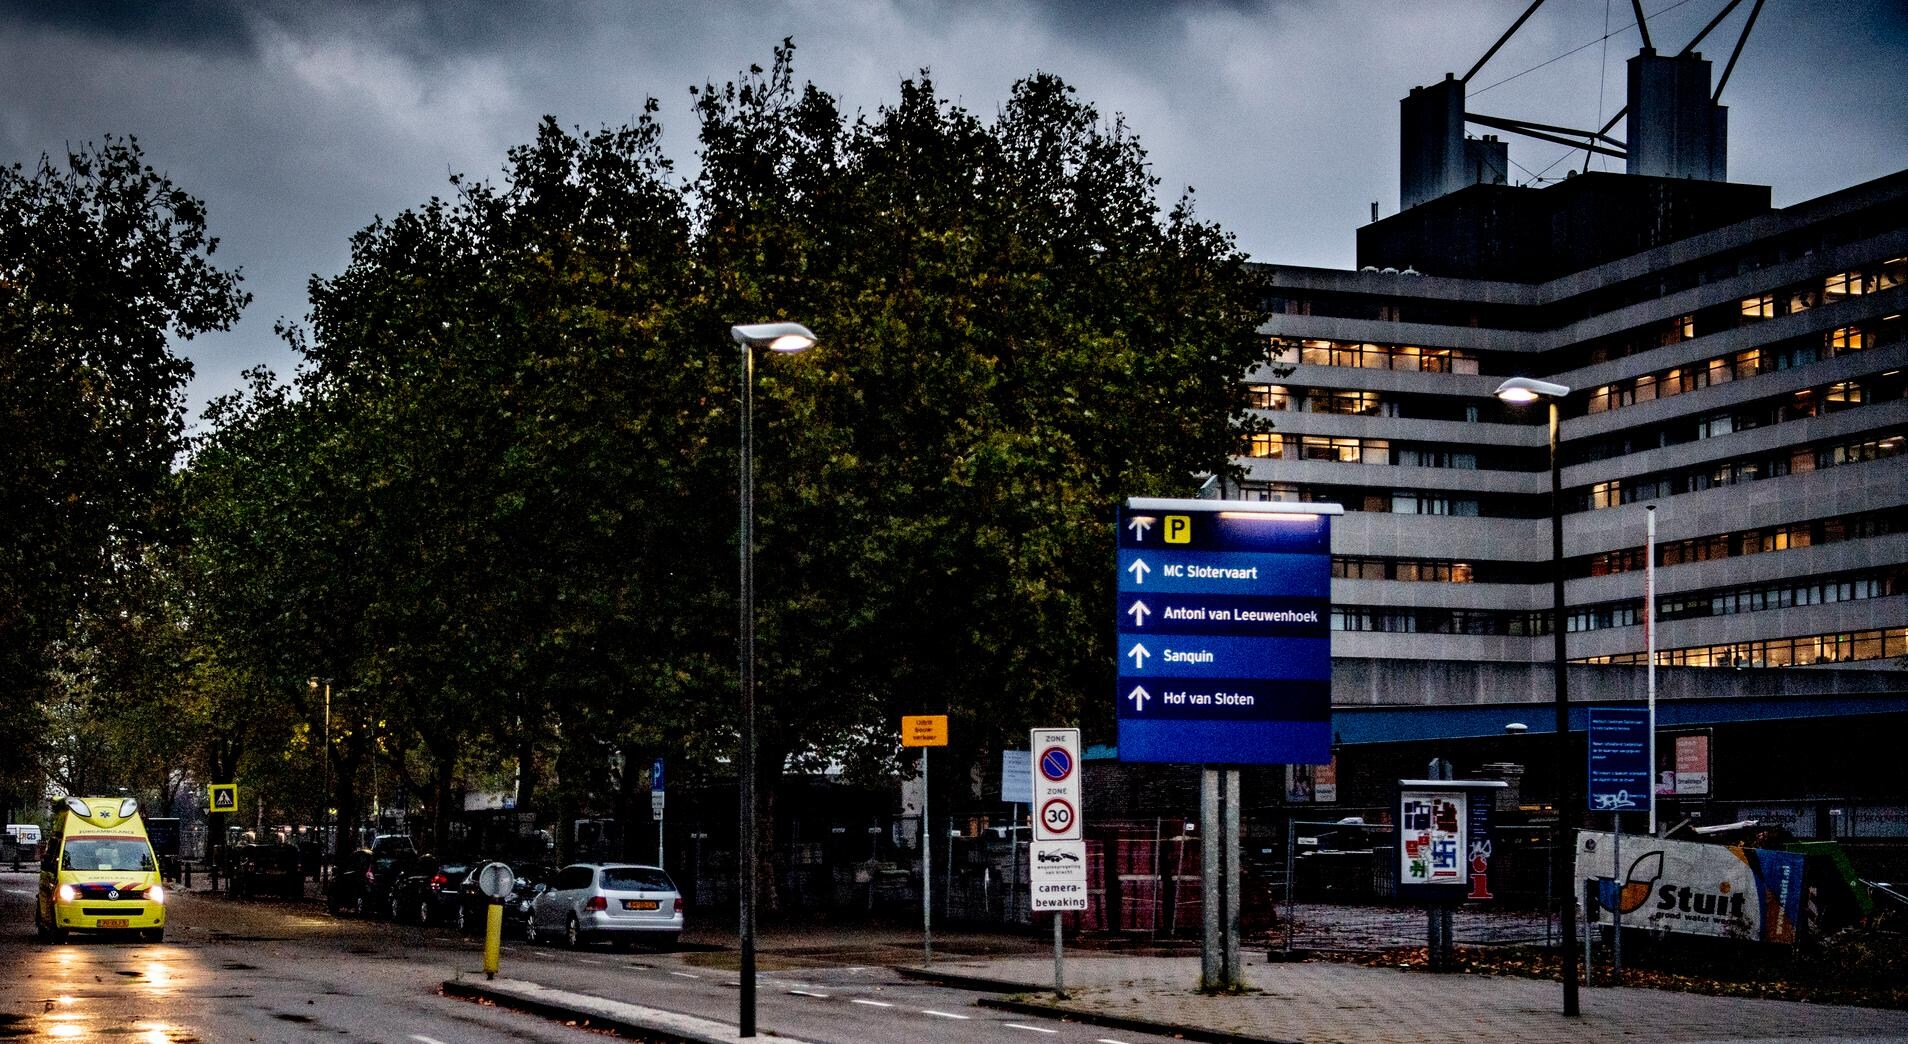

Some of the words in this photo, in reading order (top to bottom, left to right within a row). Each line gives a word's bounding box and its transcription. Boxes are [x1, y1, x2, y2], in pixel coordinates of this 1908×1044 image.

[1171, 519, 1185, 540] P
[1164, 565, 1184, 578] MC
[1187, 565, 1258, 580] Slotervaart
[1163, 606, 1206, 621] Antoni
[1208, 610, 1231, 621] van
[1233, 609, 1318, 623] Leeuwenhoek
[1163, 649, 1214, 665] Sanquin
[1164, 692, 1186, 705] Hof
[1189, 695, 1212, 705] van
[1214, 692, 1254, 706] Sloten
[1045, 735, 1066, 743] ZONE
[1047, 787, 1067, 795] ZONE
[1047, 809, 1069, 824] 30
[1035, 897, 1085, 909] bewaking
[1657, 881, 1746, 917] Stuit
[1684, 914, 1710, 923] water
